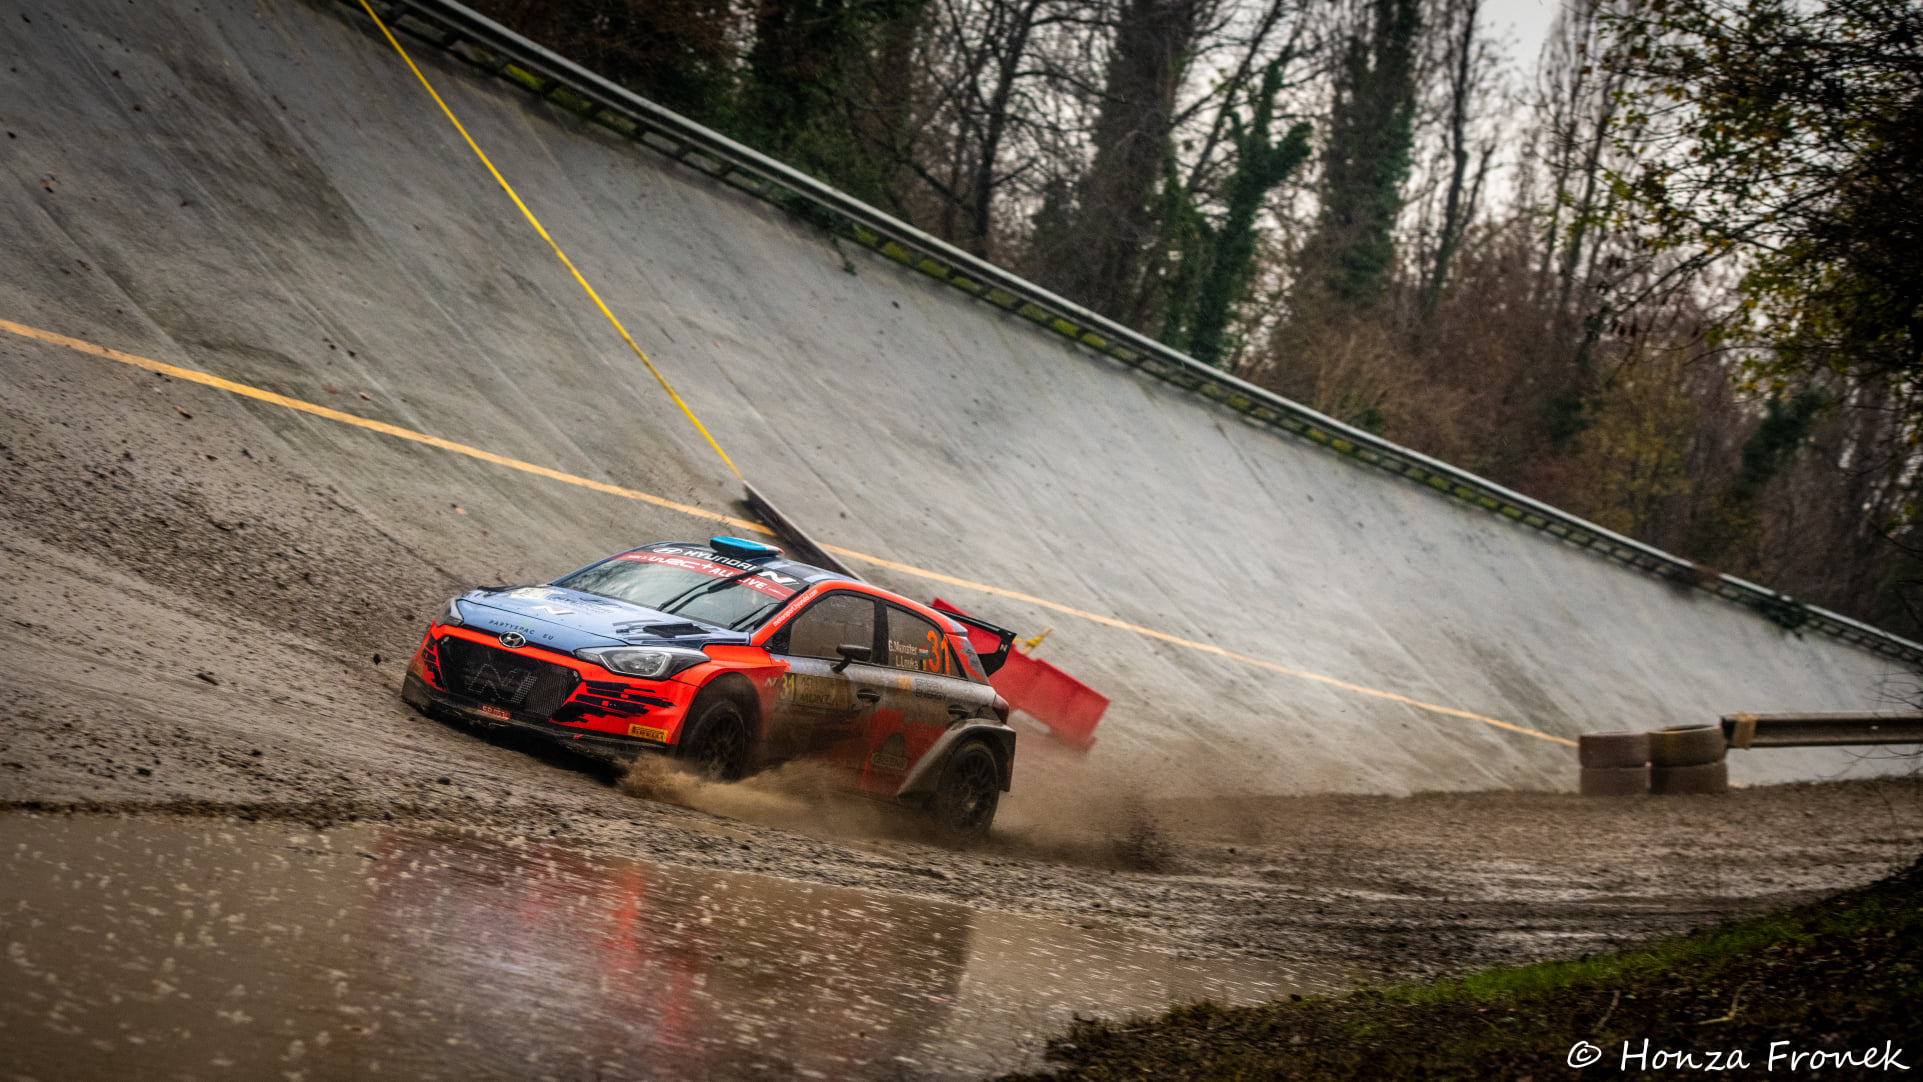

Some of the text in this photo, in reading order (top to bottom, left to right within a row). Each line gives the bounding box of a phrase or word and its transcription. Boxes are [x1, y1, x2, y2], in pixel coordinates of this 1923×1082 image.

[684, 550, 757, 571] HYUNDAI
[708, 567, 734, 578] ALL
[773, 589, 819, 627] motorsport.hyundai.com
[927, 630, 950, 676] 31
[780, 674, 795, 700] 31
